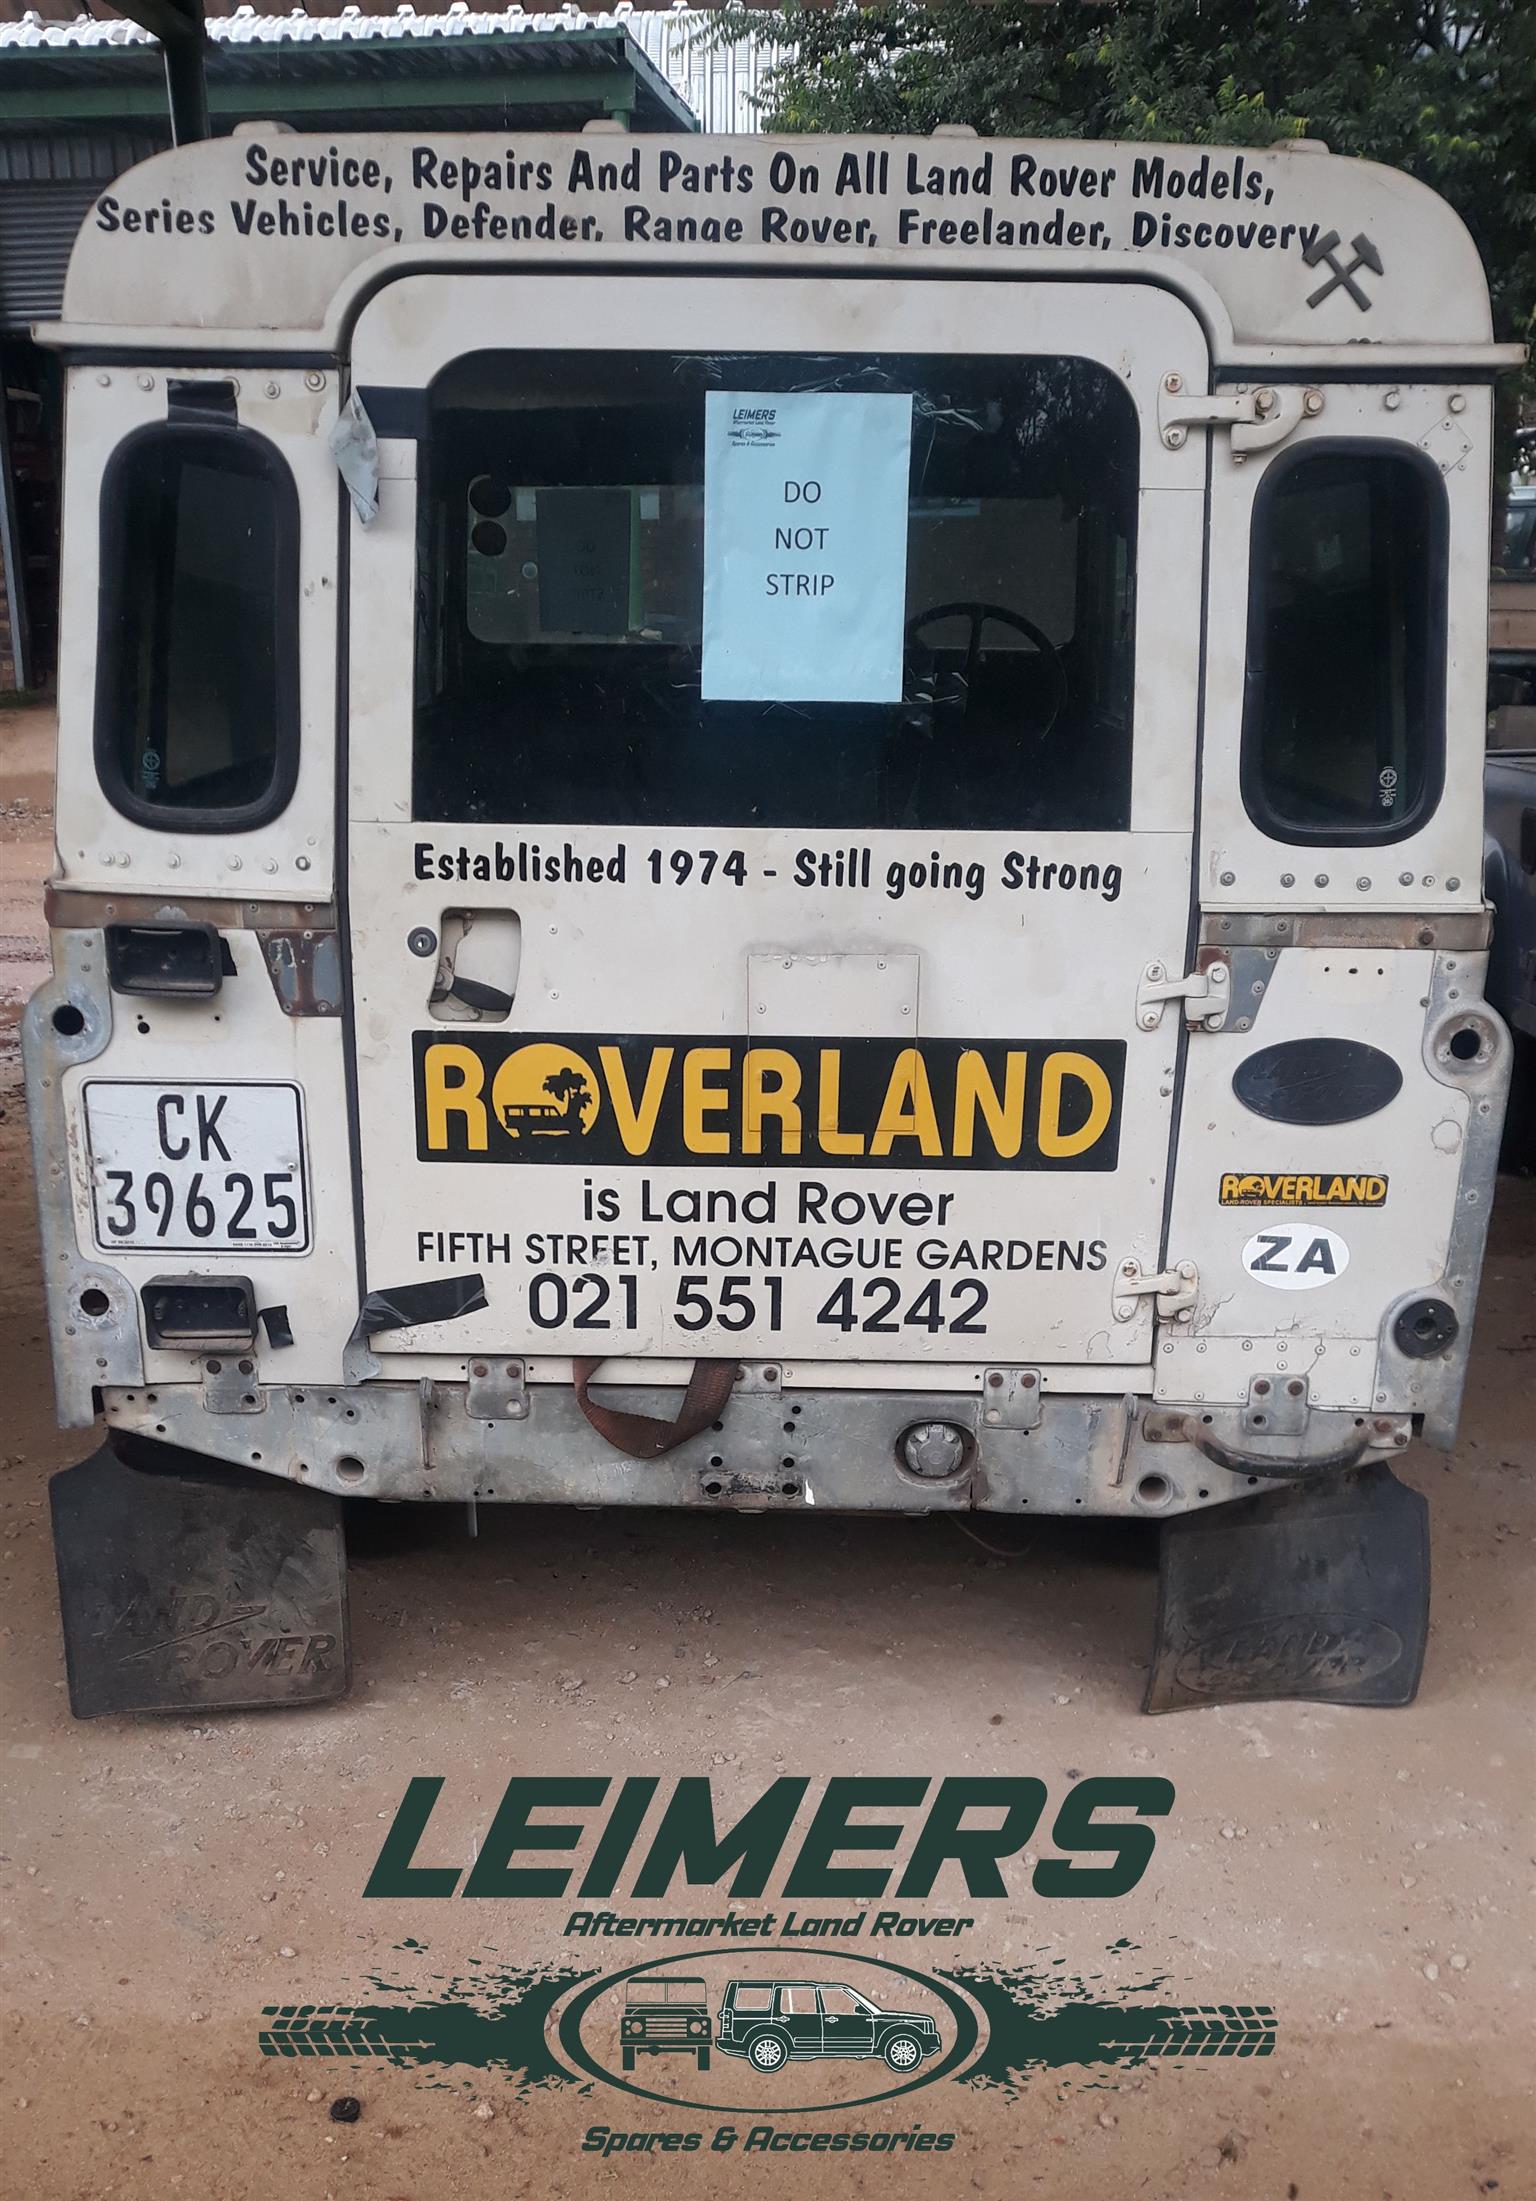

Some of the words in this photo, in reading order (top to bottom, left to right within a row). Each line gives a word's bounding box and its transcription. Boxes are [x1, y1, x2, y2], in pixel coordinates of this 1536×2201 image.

[245, 143, 393, 194] Service,
[412, 146, 552, 203] Repairs
[567, 147, 641, 194] And
[659, 150, 754, 194] Parts
[769, 151, 819, 195] On
[834, 150, 889, 197] All
[906, 151, 993, 196] Land
[1010, 153, 1116, 198] Rover
[1132, 154, 1274, 206] Models,
[96, 197, 215, 235] Series
[230, 198, 403, 243] Vehicles,
[761, 206, 878, 248] Rover,
[898, 207, 1111, 251] Freelander,
[1132, 211, 1319, 256] Discovery
[732, 409, 777, 420] LEIMERS
[784, 480, 822, 504] DO
[775, 527, 830, 550] NOT
[766, 573, 835, 596] STRIP
[414, 841, 626, 884] Established
[647, 848, 748, 887] 1974
[793, 847, 871, 888] Still
[886, 851, 985, 901] going
[1001, 850, 1122, 902] Strong
[424, 1043, 1113, 1158] ROVERLAND
[157, 1094, 232, 1162] CK
[106, 1170, 297, 1238] 39625
[584, 1178, 620, 1222] is
[642, 1179, 776, 1224] Land
[798, 1181, 954, 1227] Rover
[1221, 1175, 1387, 1201] ROVERLAND
[417, 1231, 511, 1264] FIFTH
[525, 1233, 657, 1271] STREET,
[673, 1236, 903, 1269] MONTAGUE
[915, 1237, 1108, 1271] GARDENS
[1250, 1234, 1336, 1275] ZA
[529, 1272, 637, 1330] 021
[673, 1275, 782, 1332] 551
[816, 1276, 989, 1334] 4242
